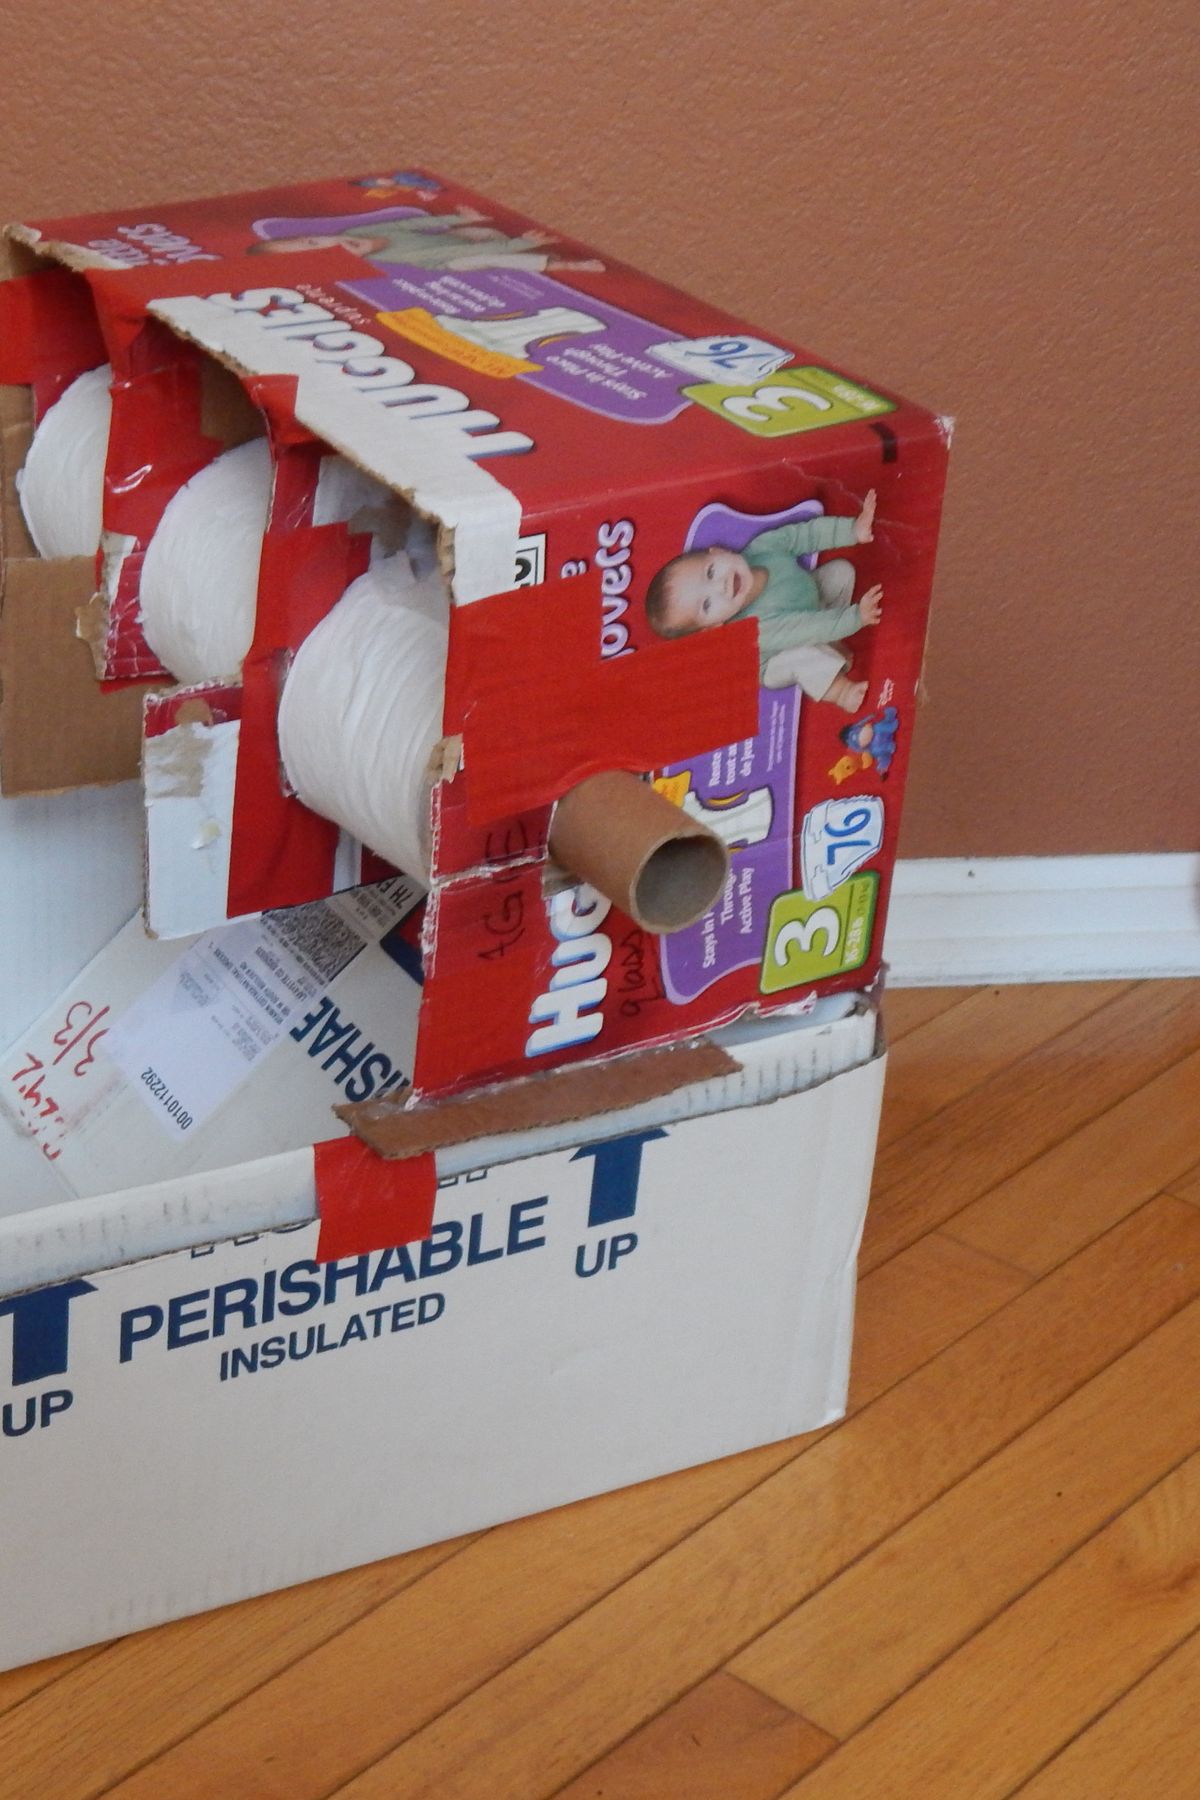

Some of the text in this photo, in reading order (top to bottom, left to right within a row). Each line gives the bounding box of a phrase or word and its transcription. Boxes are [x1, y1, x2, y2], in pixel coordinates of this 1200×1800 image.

[684, 340, 774, 369] 76
[721, 385, 833, 422] 3
[594, 517, 636, 661] overs
[824, 808, 872, 866] 76
[720, 867, 736, 924] Throug
[738, 868, 754, 932] Active Play
[701, 917, 714, 934] in
[702, 932, 717, 968] Stays
[774, 906, 842, 967] 3
[52, 1000, 111, 1077] 3/3
[141, 1066, 193, 1130] 0010112292
[119, 1196, 549, 1364] PERISHABLE
[575, 1233, 638, 1279] UP
[219, 1292, 445, 1382] INSULATED
[2, 1389, 74, 1437] UP
